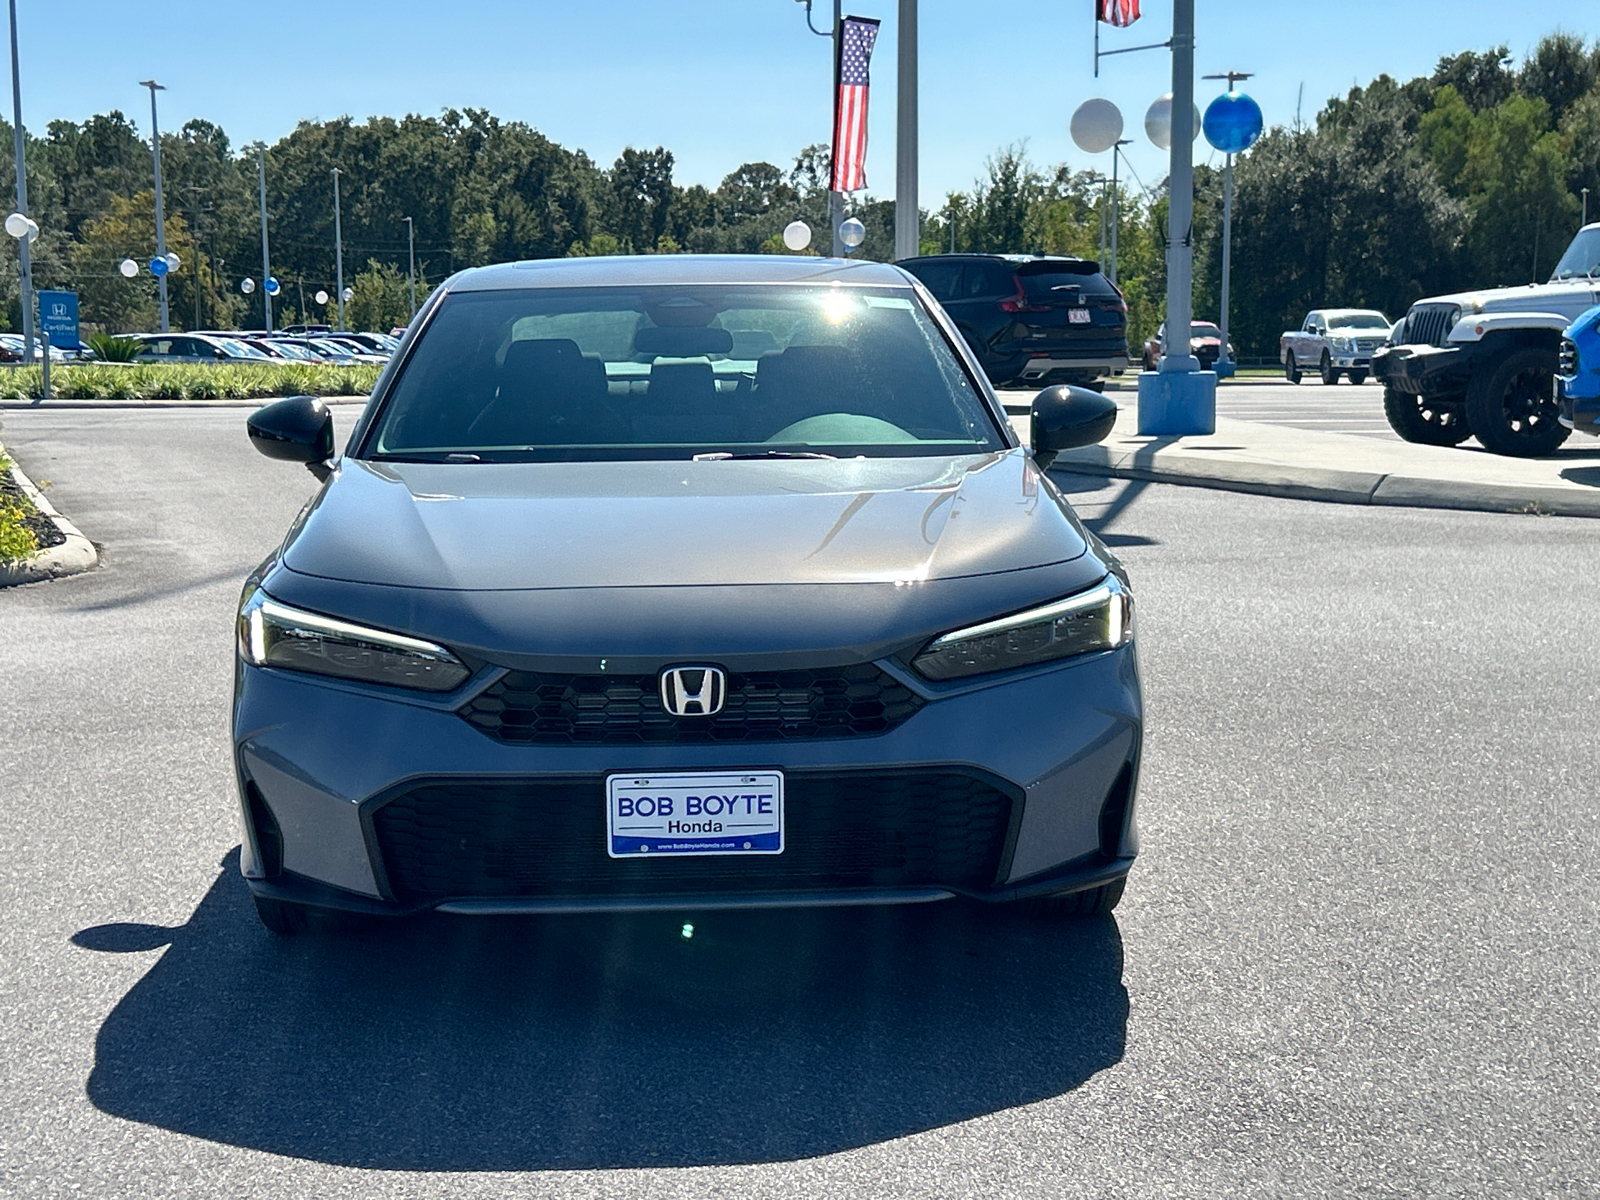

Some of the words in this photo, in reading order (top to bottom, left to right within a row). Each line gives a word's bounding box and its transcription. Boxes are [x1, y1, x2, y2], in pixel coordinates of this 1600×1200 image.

[44, 323, 76, 331] Certified
[618, 797, 674, 817] BOB
[686, 795, 773, 816] BOYTE
[668, 820, 723, 834] Honda
